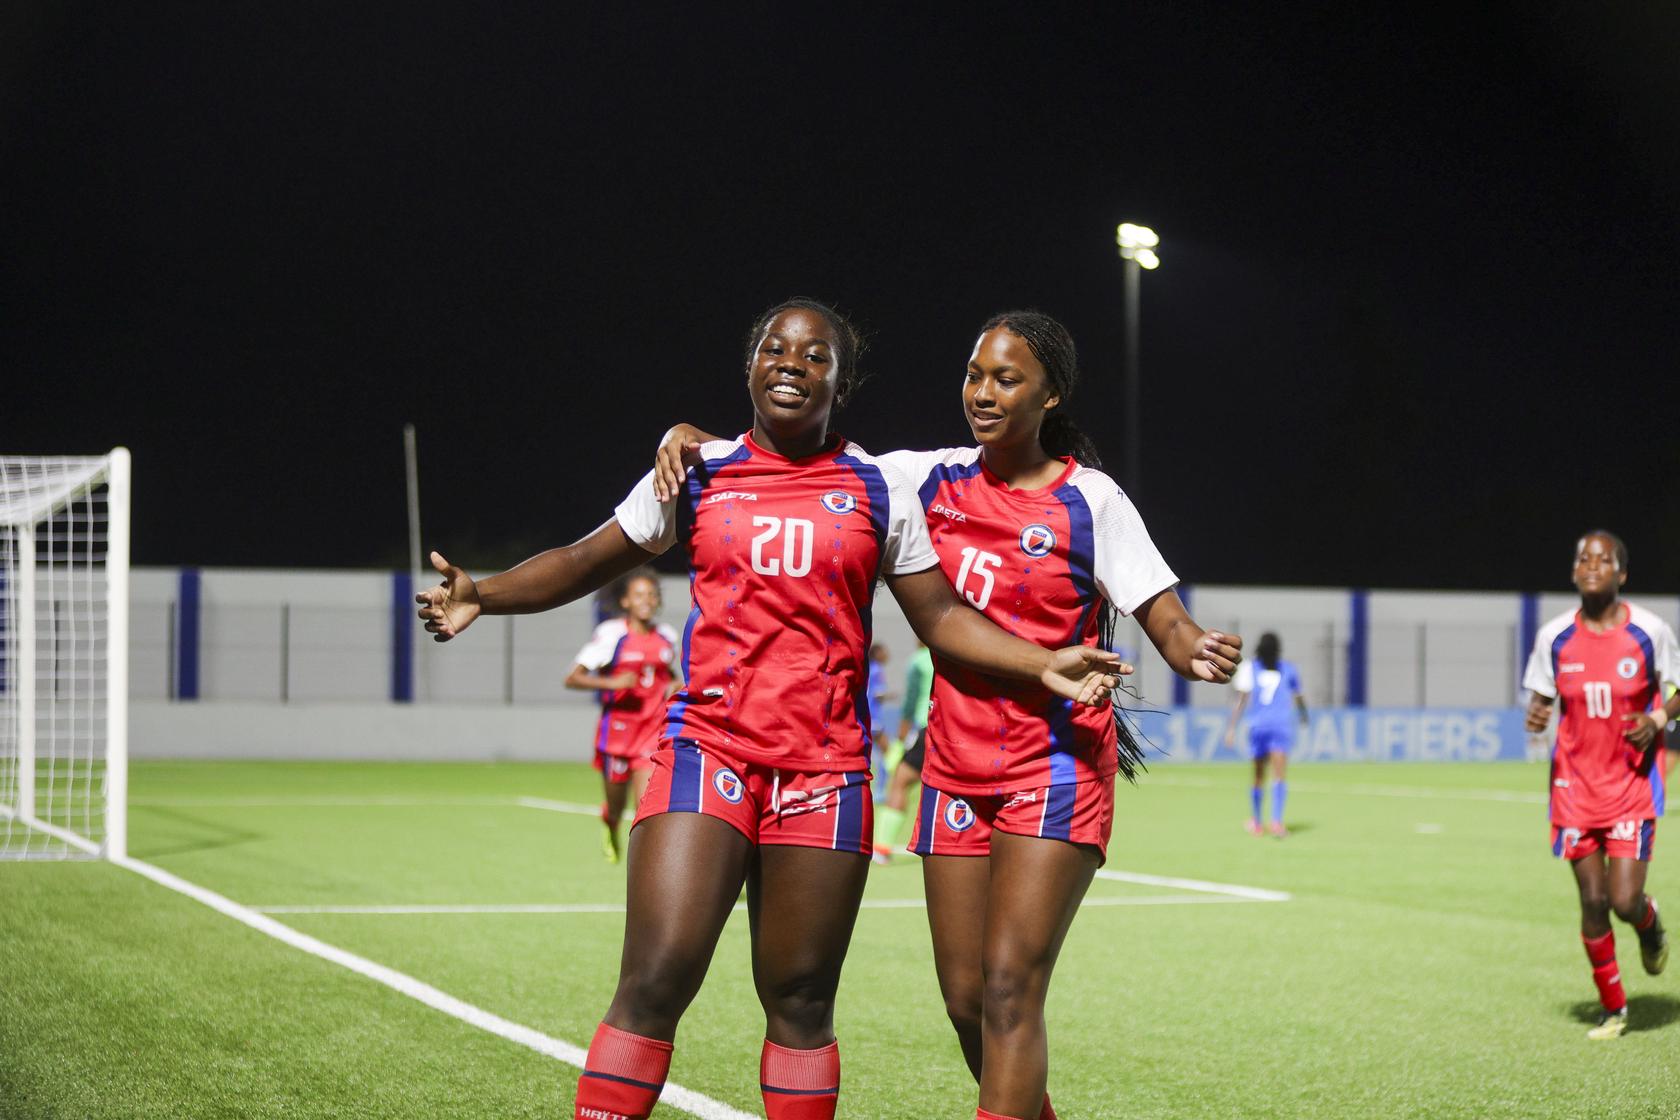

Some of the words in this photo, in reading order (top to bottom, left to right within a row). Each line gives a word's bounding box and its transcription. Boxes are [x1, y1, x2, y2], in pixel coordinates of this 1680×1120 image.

[705, 491, 758, 504] SAETA
[931, 504, 967, 523] SAETA
[751, 515, 815, 578] 20
[955, 546, 1003, 611] 15
[1256, 670, 1282, 706] 7
[1583, 681, 1613, 719] 10
[1237, 713, 1501, 761] ALIFIERS
